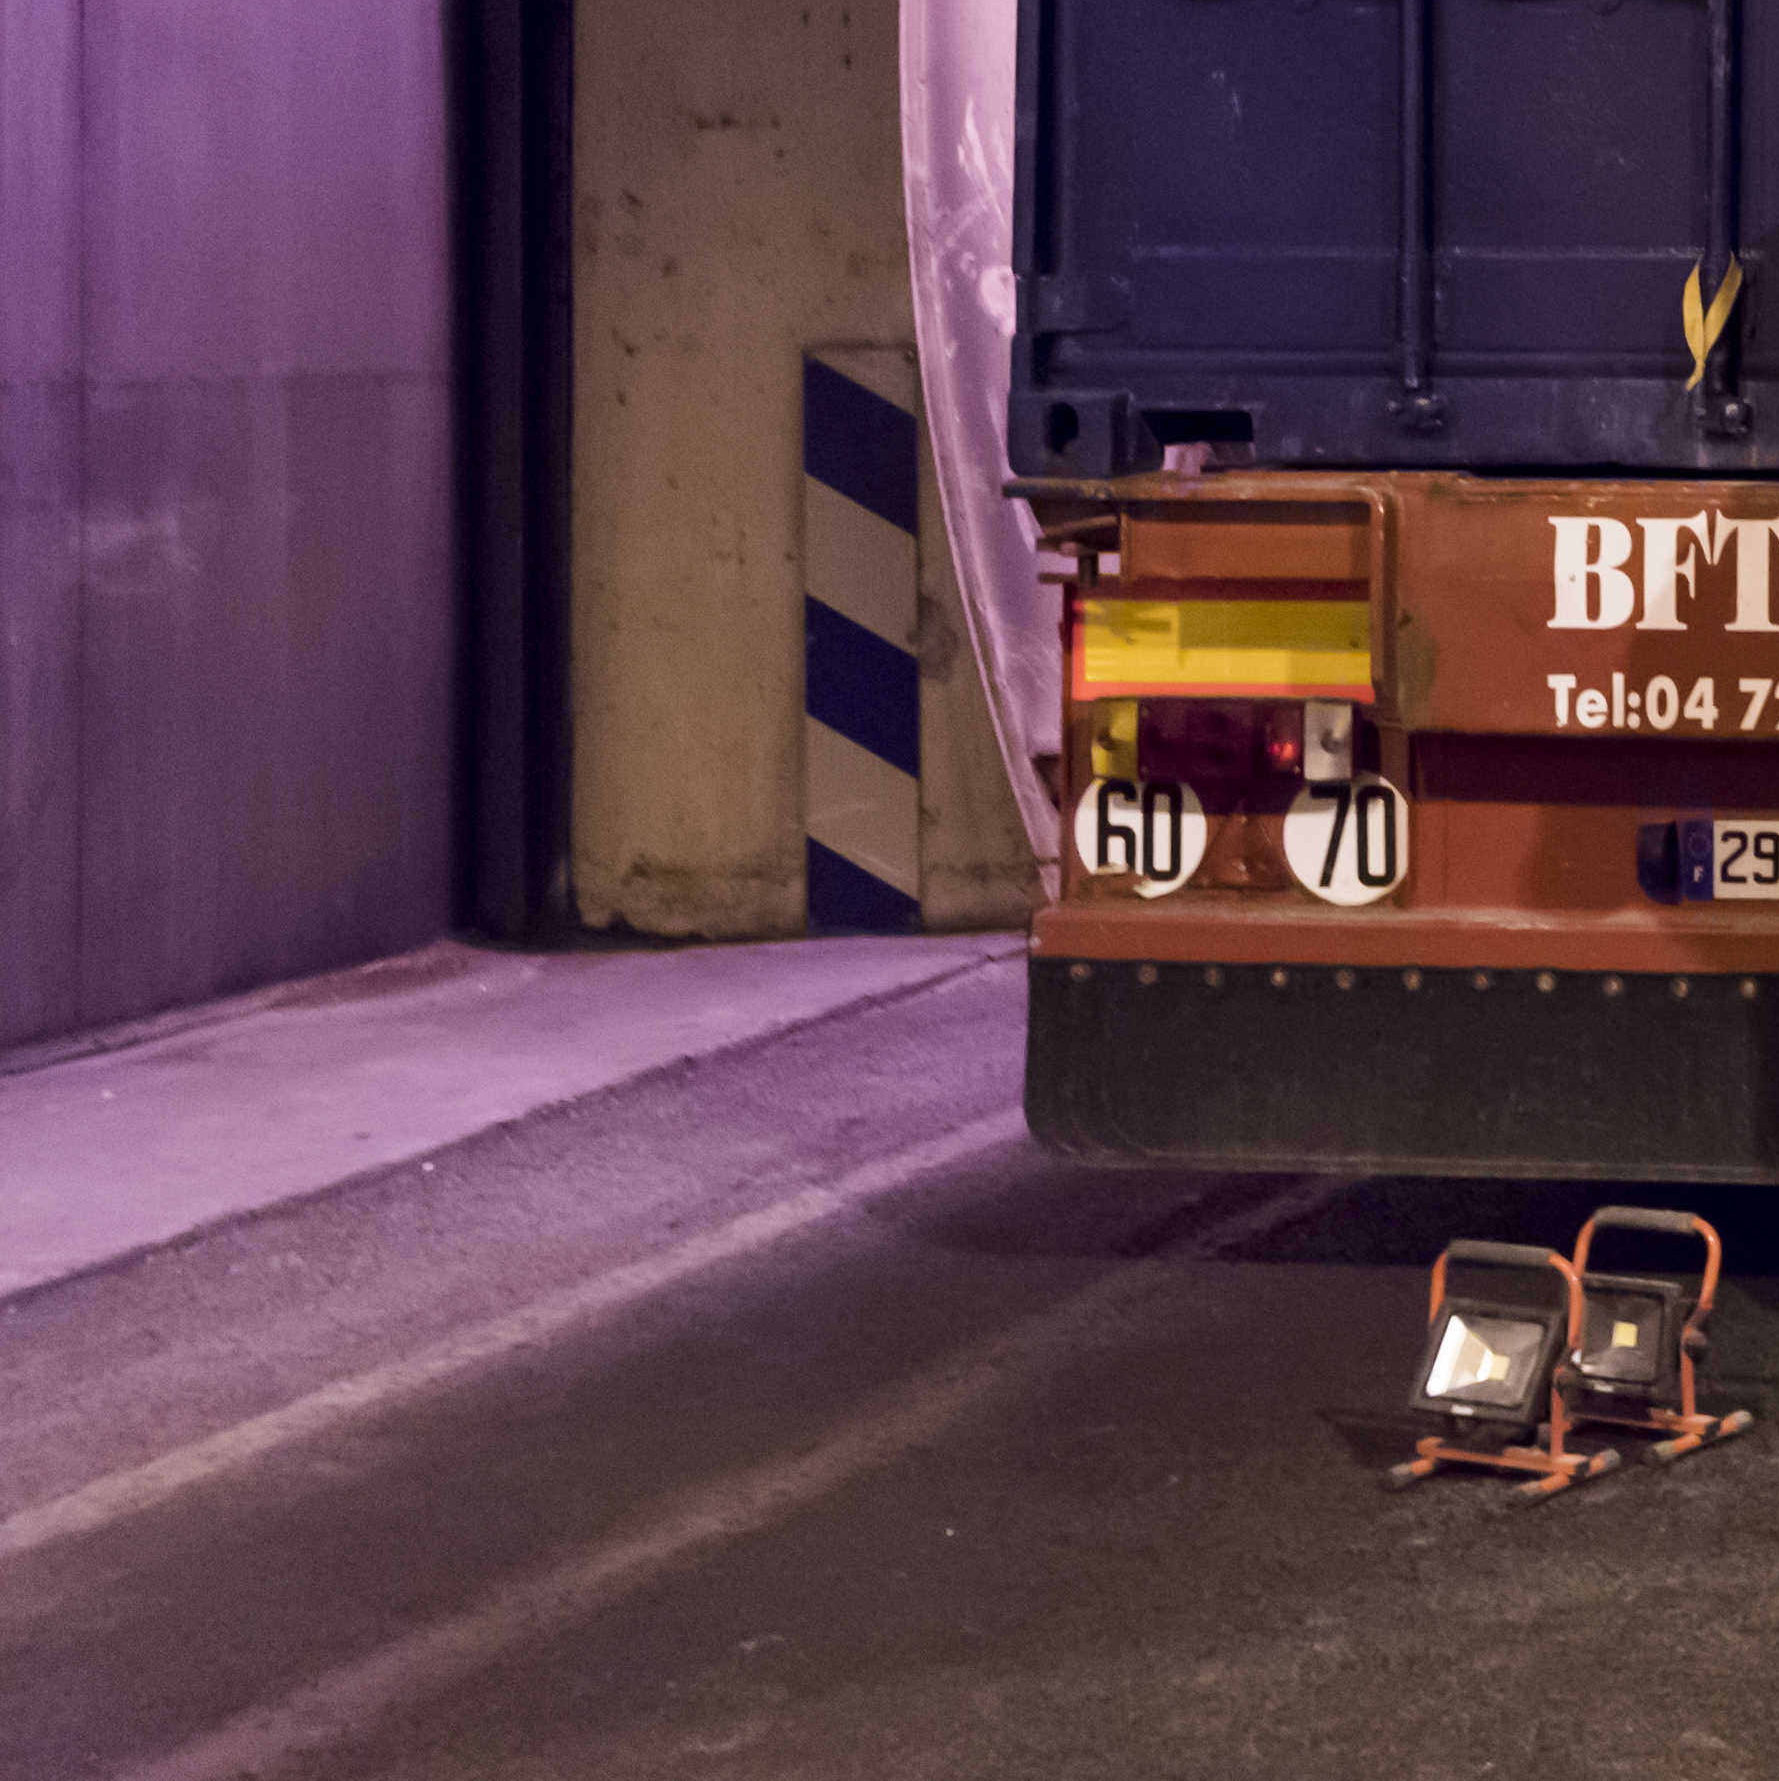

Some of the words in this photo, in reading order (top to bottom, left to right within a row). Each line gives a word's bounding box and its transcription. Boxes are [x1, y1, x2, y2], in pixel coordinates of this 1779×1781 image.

[1547, 672, 1719, 731] Tel:04
[1098, 779, 1182, 881] 60
[1310, 784, 1396, 888] 70
